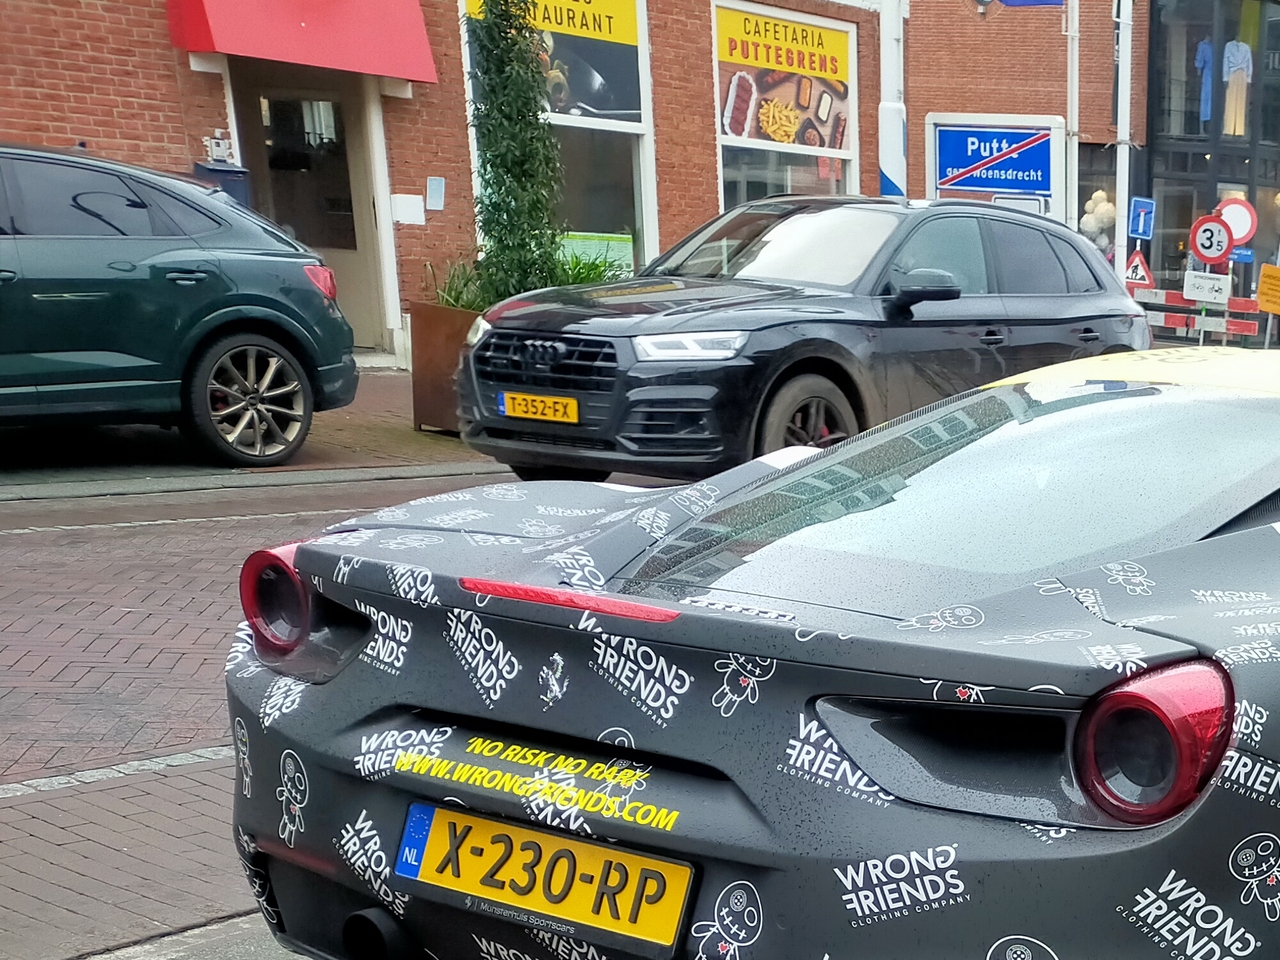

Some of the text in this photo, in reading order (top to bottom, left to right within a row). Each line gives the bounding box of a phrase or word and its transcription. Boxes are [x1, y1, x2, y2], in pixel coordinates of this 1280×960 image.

[528, 4, 614, 34] TAURANT
[743, 17, 825, 49] CAFETARIA
[727, 36, 838, 74] PUTTEGRENS
[1200, 228, 1214, 250] 3
[1216, 240, 1224, 252] 5
[509, 396, 570, 418] T-352-FX
[446, 611, 506, 701] FRIENDS
[1213, 639, 1273, 659] RONG
[468, 672, 495, 710] COMPANY
[588, 661, 668, 729] CLOTHING COMPANY
[594, 639, 680, 720] FRIENDS
[361, 726, 453, 754] WRONG
[500, 743, 555, 768] RISK
[549, 755, 588, 775] NO
[395, 750, 680, 832] WWW.WRONGFRIENDS.COM
[776, 763, 891, 810] CLOTHING COMPANY
[1210, 777, 1266, 802] CLOTHING
[340, 822, 406, 914] FRIENDS
[402, 846, 419, 866] NL
[435, 820, 667, 925] X-230-RP
[833, 844, 957, 891] WRONG
[841, 869, 965, 917] FRIENDS
[851, 894, 973, 929] CLOTHING COMPANY
[480, 902, 576, 935] Munsterhuis Sportscars
[1115, 904, 1168, 949] CLOTHING
[1158, 868, 1256, 957] WRONG
